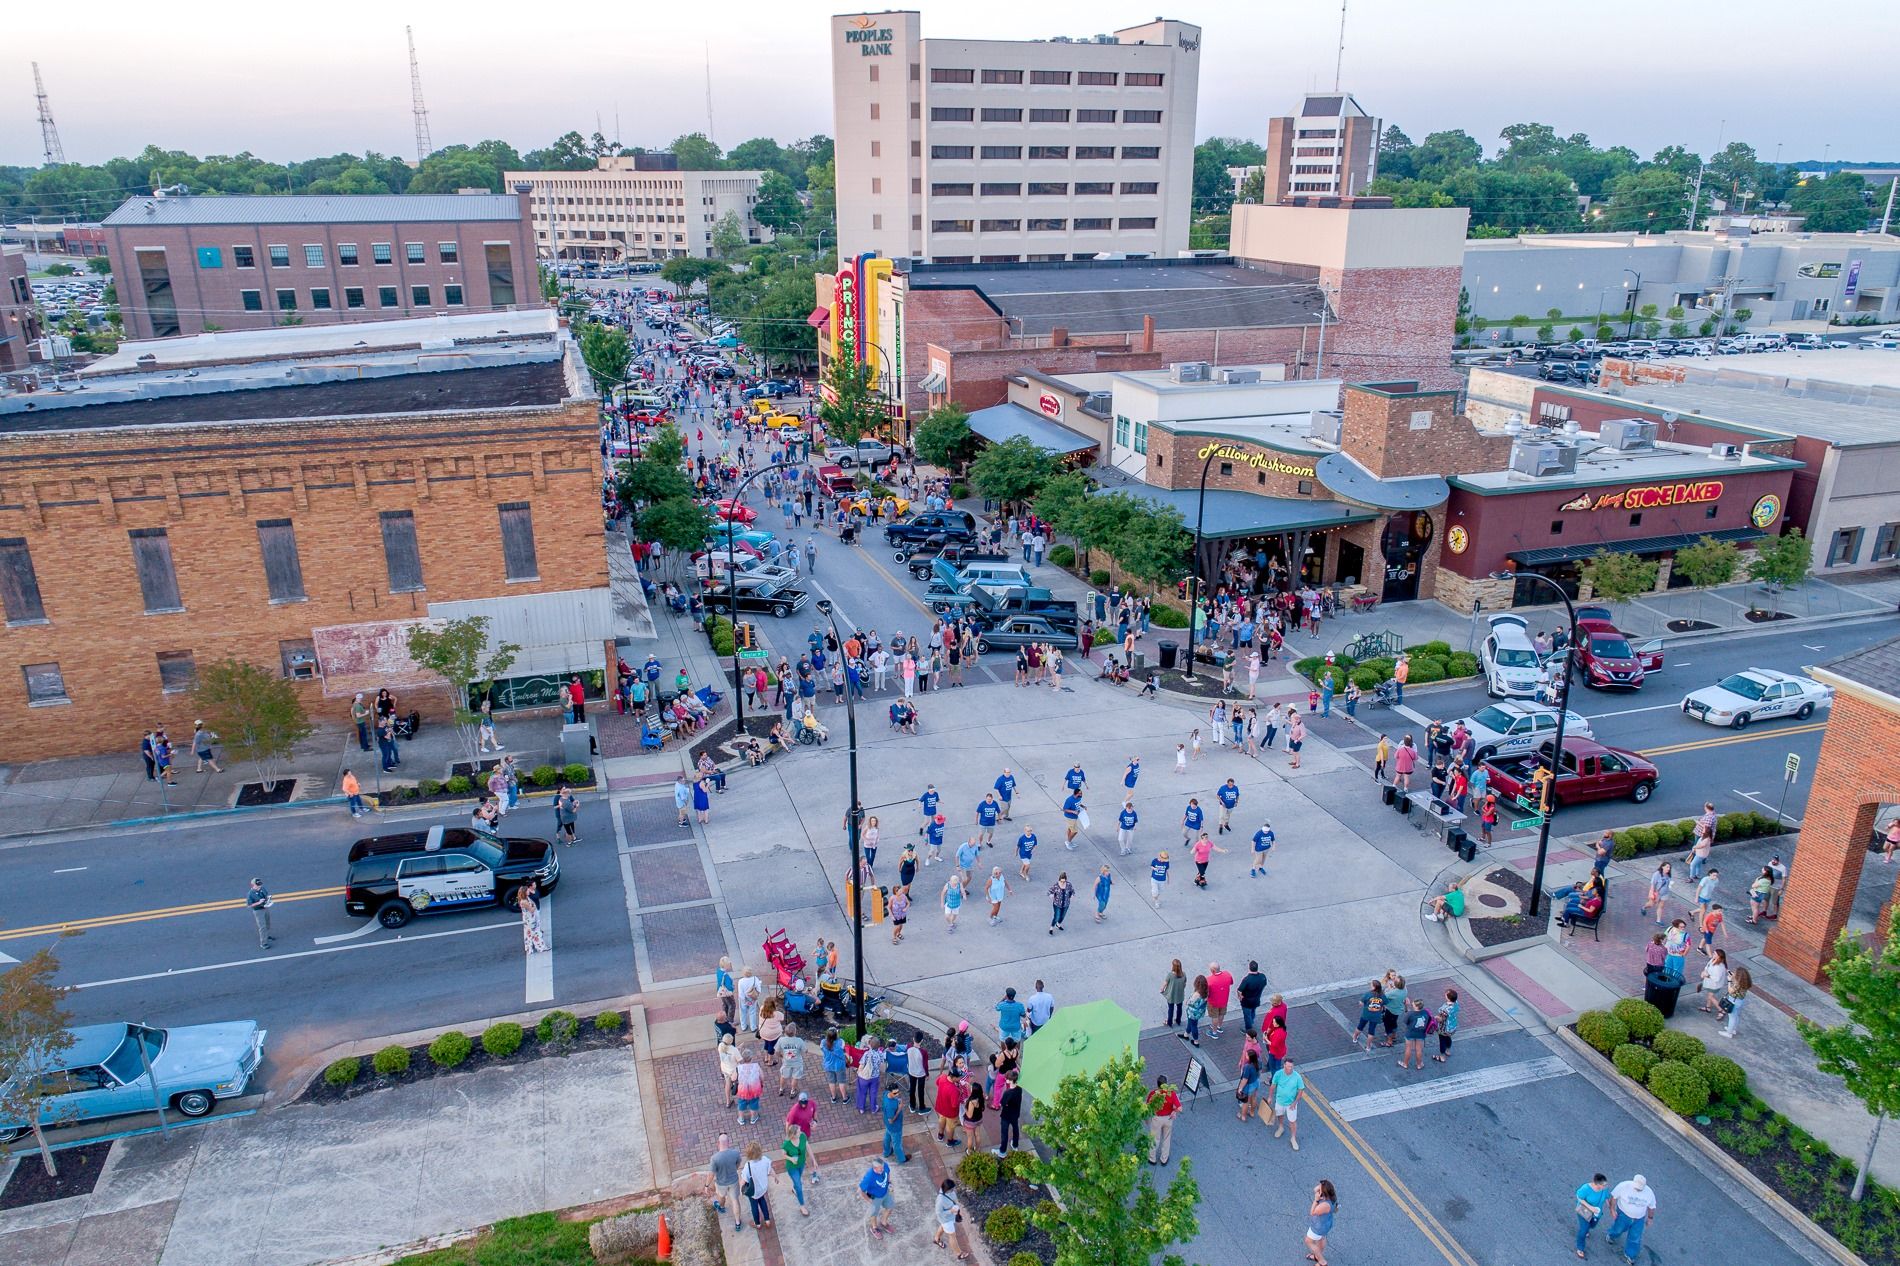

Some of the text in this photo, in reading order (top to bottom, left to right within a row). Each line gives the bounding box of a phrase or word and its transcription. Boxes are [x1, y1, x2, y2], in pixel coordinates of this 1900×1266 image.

[845, 28, 893, 43] PEOPLES
[861, 43, 892, 57] BANK
[842, 277, 855, 380] PRINC
[1197, 442, 1314, 477] Mellow Mushroom
[1625, 486, 1673, 509] STONE
[1674, 482, 1723, 504] BAKED
[1760, 704, 1782, 712] POLICE
[1507, 738, 1532, 746] POLICE
[433, 889, 491, 902] POLICE
